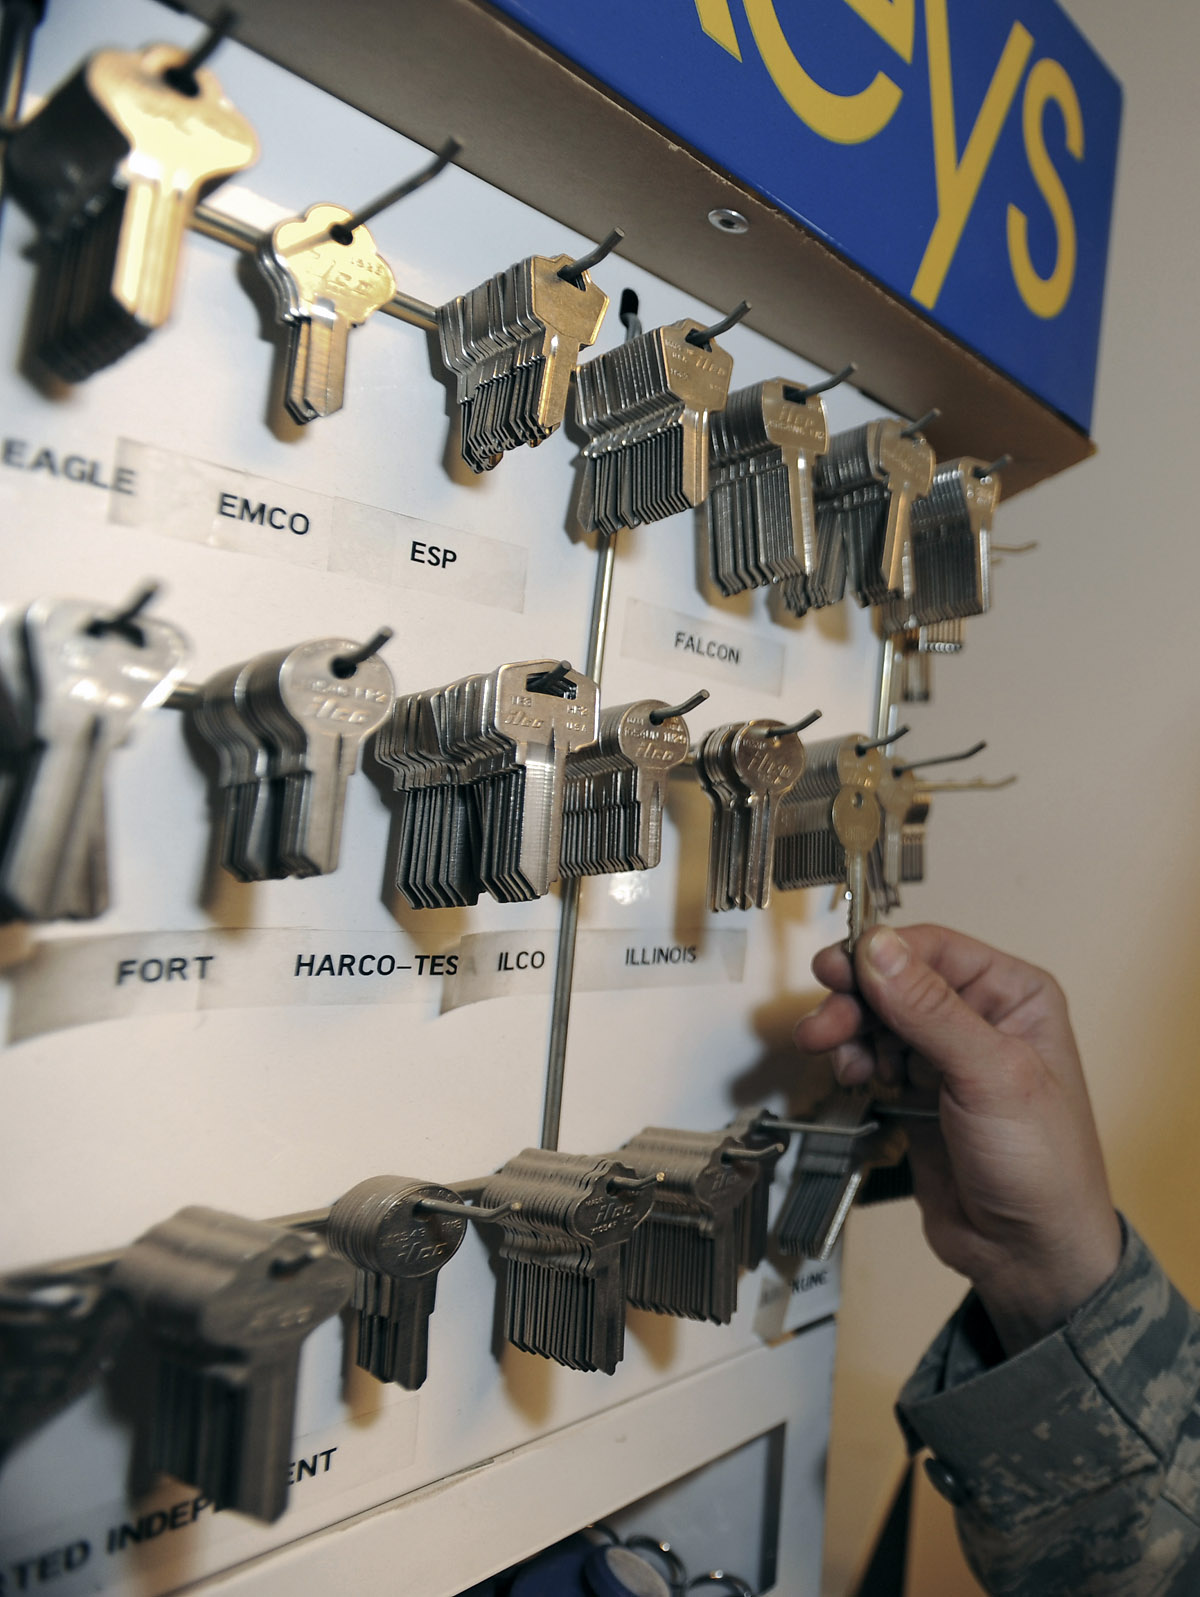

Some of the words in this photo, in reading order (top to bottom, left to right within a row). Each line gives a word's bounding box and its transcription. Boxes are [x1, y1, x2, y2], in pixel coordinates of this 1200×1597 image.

[695, 0, 1084, 319] eys
[1, 438, 137, 496] EAGLE
[217, 492, 310, 535] EMCO
[410, 540, 458, 569] ESP
[674, 631, 740, 665] FALCON
[115, 955, 215, 986] FORT
[498, 951, 546, 972] ILCO
[625, 946, 697, 966] ILLINOIS
[0, 1539, 91, 1597] TED
